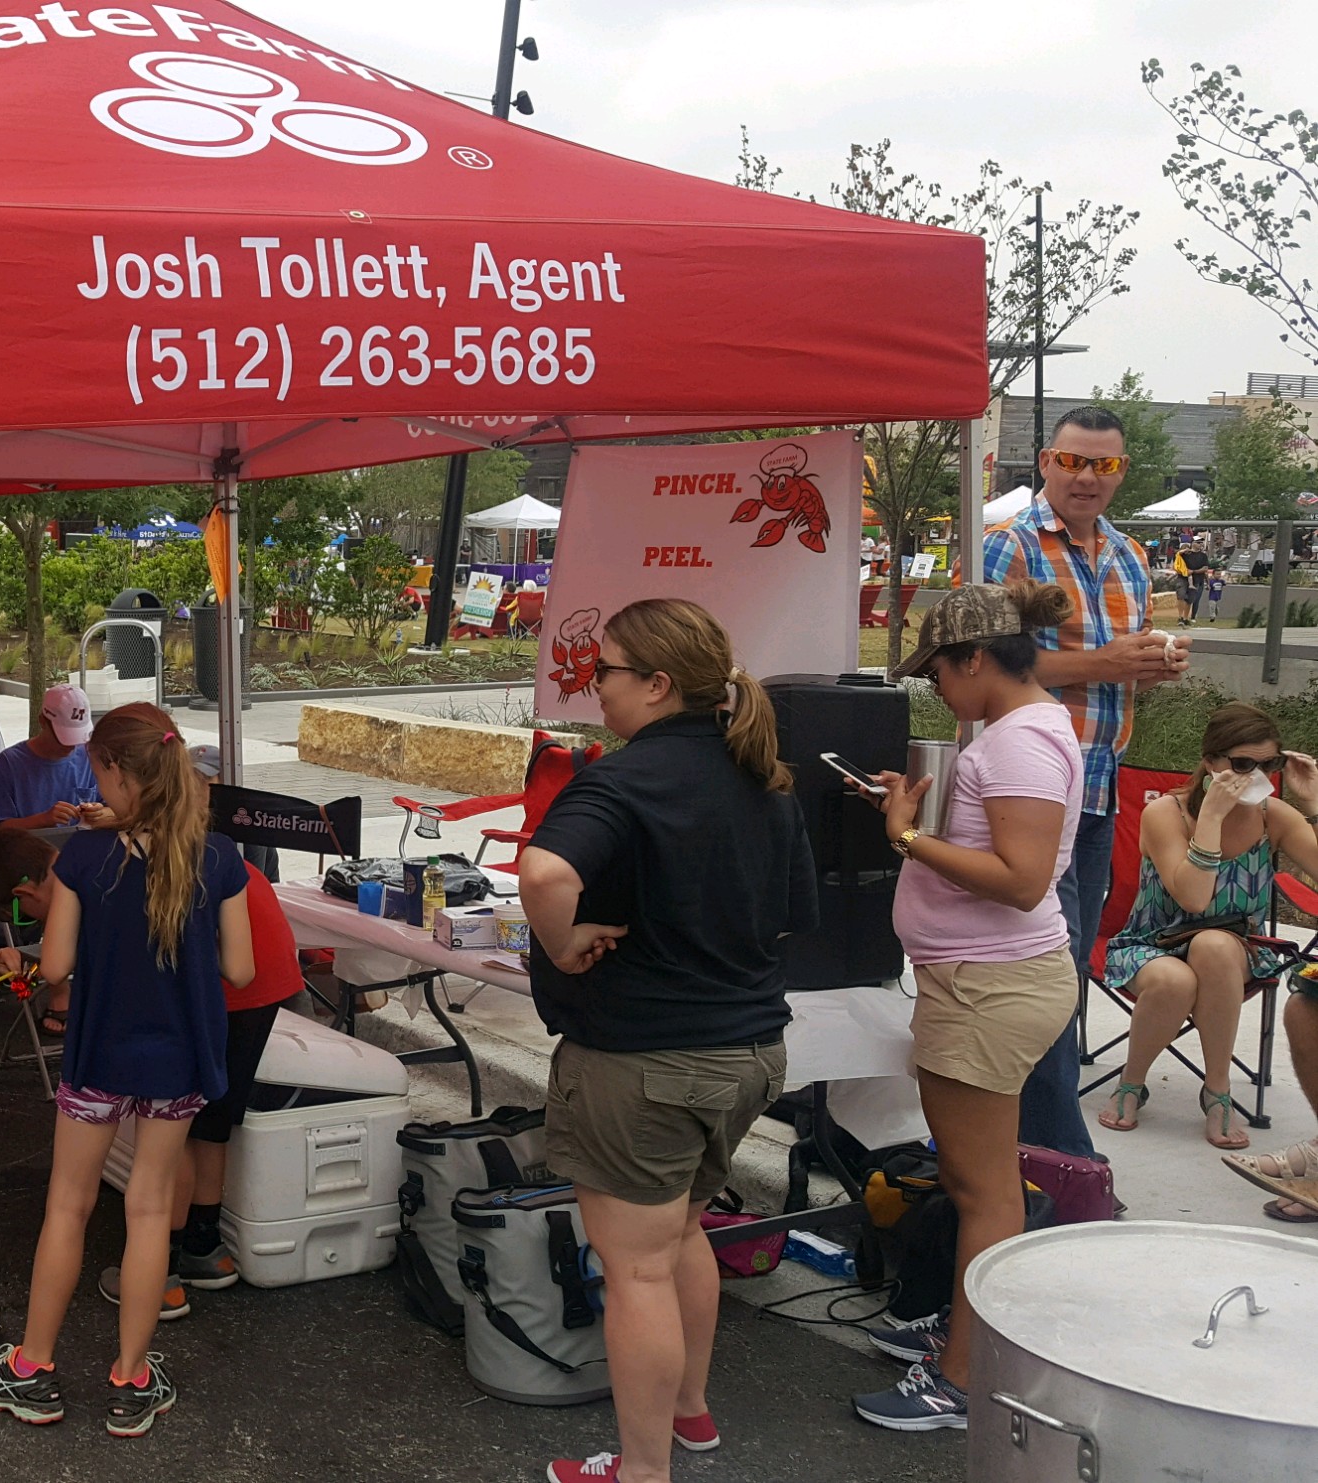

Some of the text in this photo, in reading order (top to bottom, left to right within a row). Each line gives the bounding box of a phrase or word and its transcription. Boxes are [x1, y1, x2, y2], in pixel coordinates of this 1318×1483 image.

[77, 235, 626, 313] Josh Tollett, Agent
[125, 323, 597, 404] (512) 263-5685
[783, 454, 798, 463] FARM
[653, 473, 742, 496] PINCH.
[642, 546, 712, 567] PEEL.
[71, 707, 85, 721] LT
